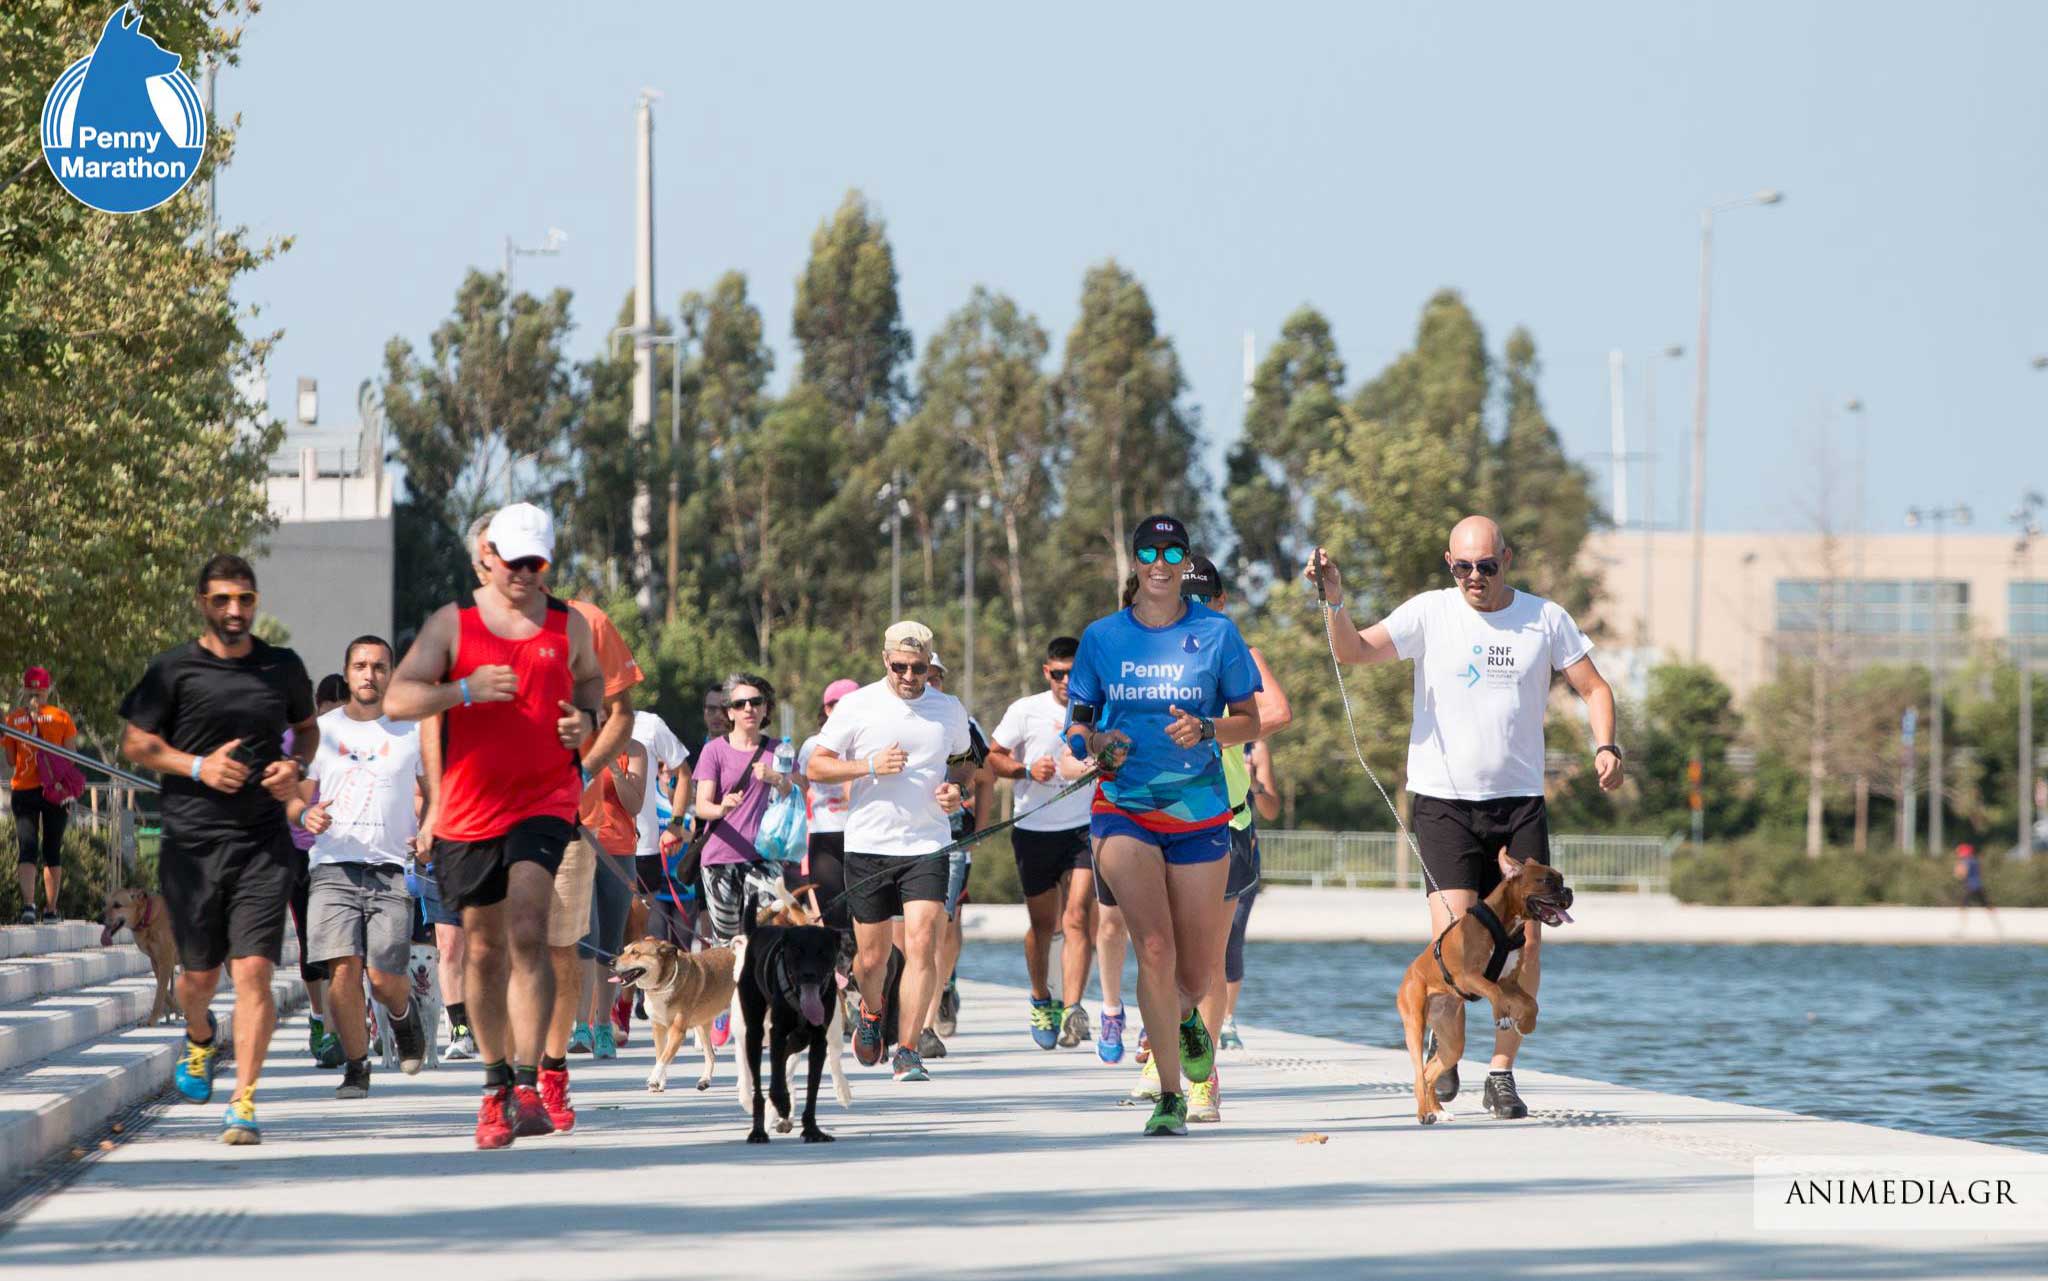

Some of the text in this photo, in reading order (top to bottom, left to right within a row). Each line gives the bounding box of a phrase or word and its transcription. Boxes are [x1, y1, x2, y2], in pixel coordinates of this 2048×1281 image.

[1488, 646, 1512, 656] SNF
[1487, 656, 1514, 667] RUN
[1121, 661, 1185, 681] Penny
[1108, 683, 1202, 701] Marathon
